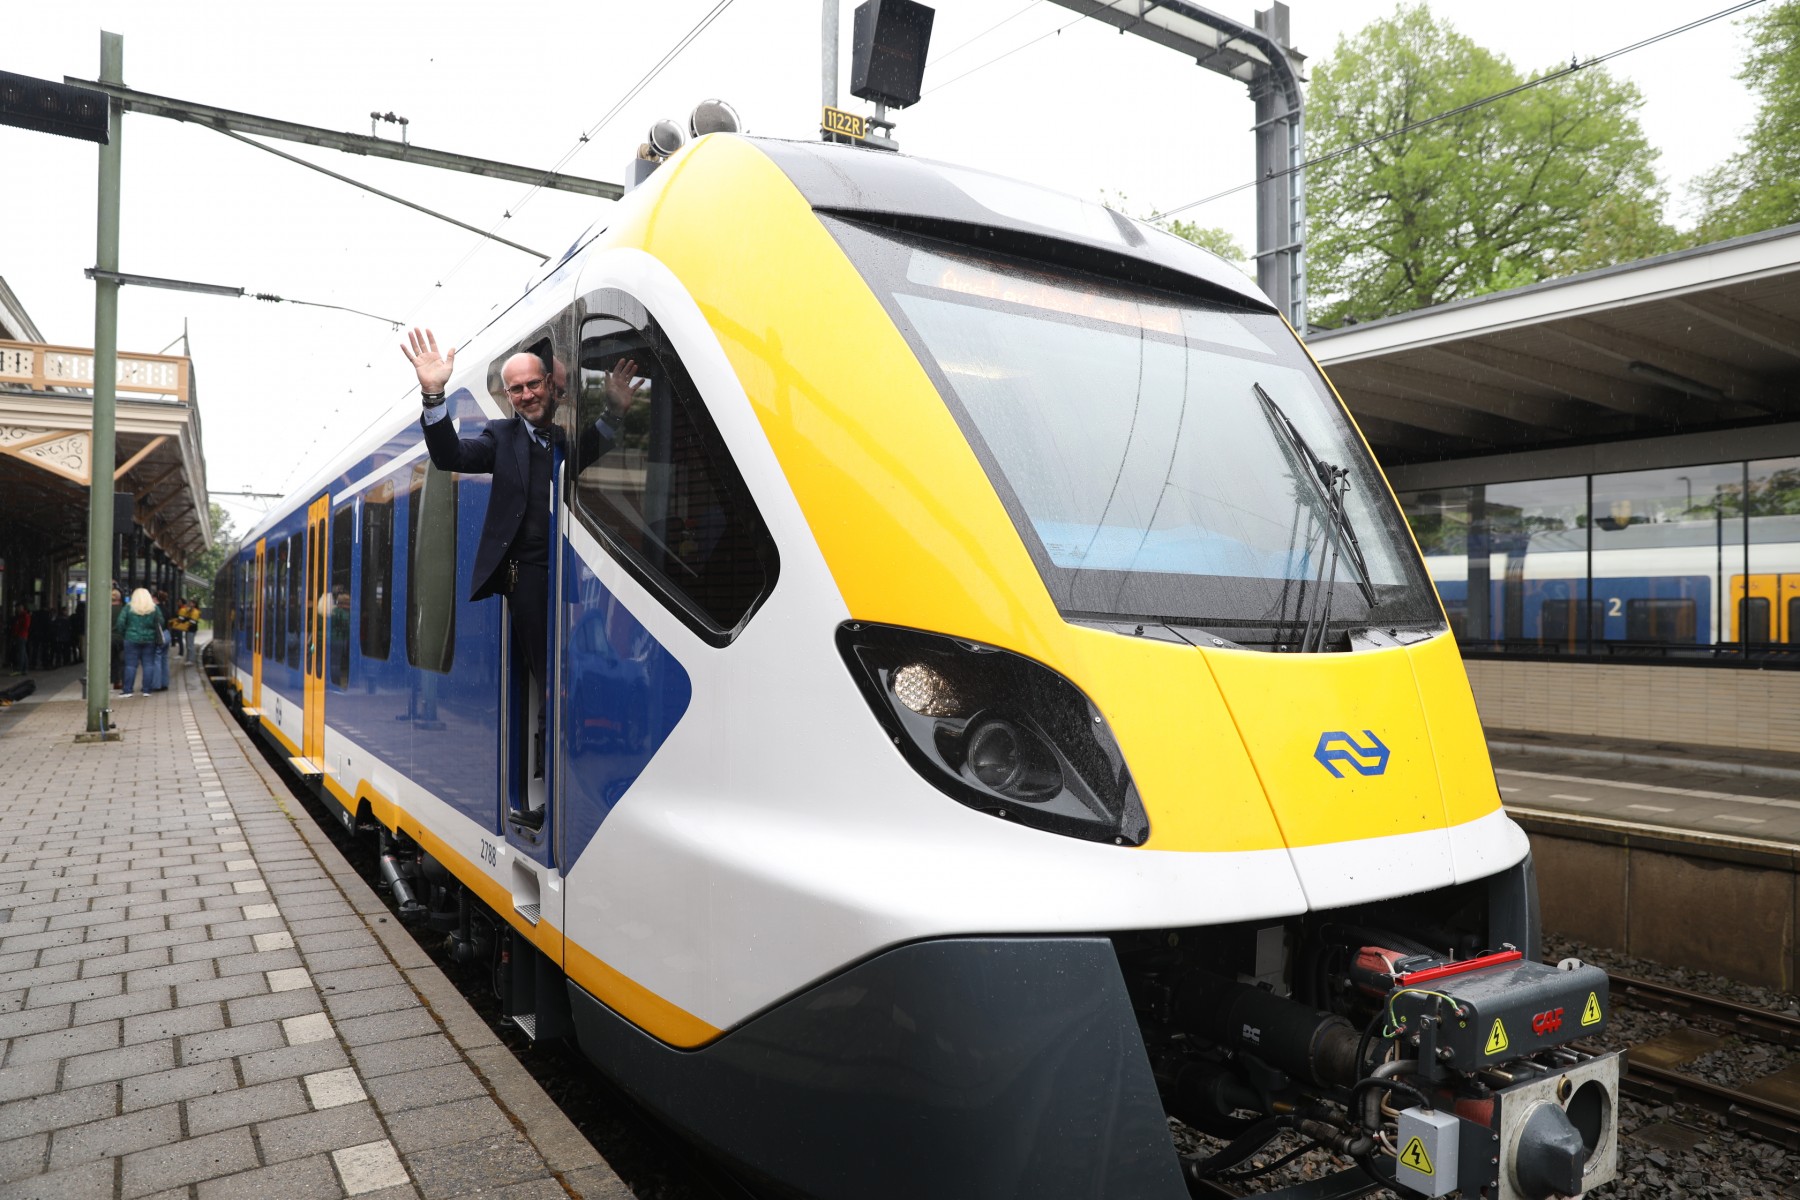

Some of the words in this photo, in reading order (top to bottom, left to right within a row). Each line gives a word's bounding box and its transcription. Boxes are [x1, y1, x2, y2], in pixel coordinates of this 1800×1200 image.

[827, 110, 861, 135] 1122R
[1607, 597, 1623, 617] 2
[480, 838, 497, 868] 2788
[1532, 1006, 1565, 1036] CAF
